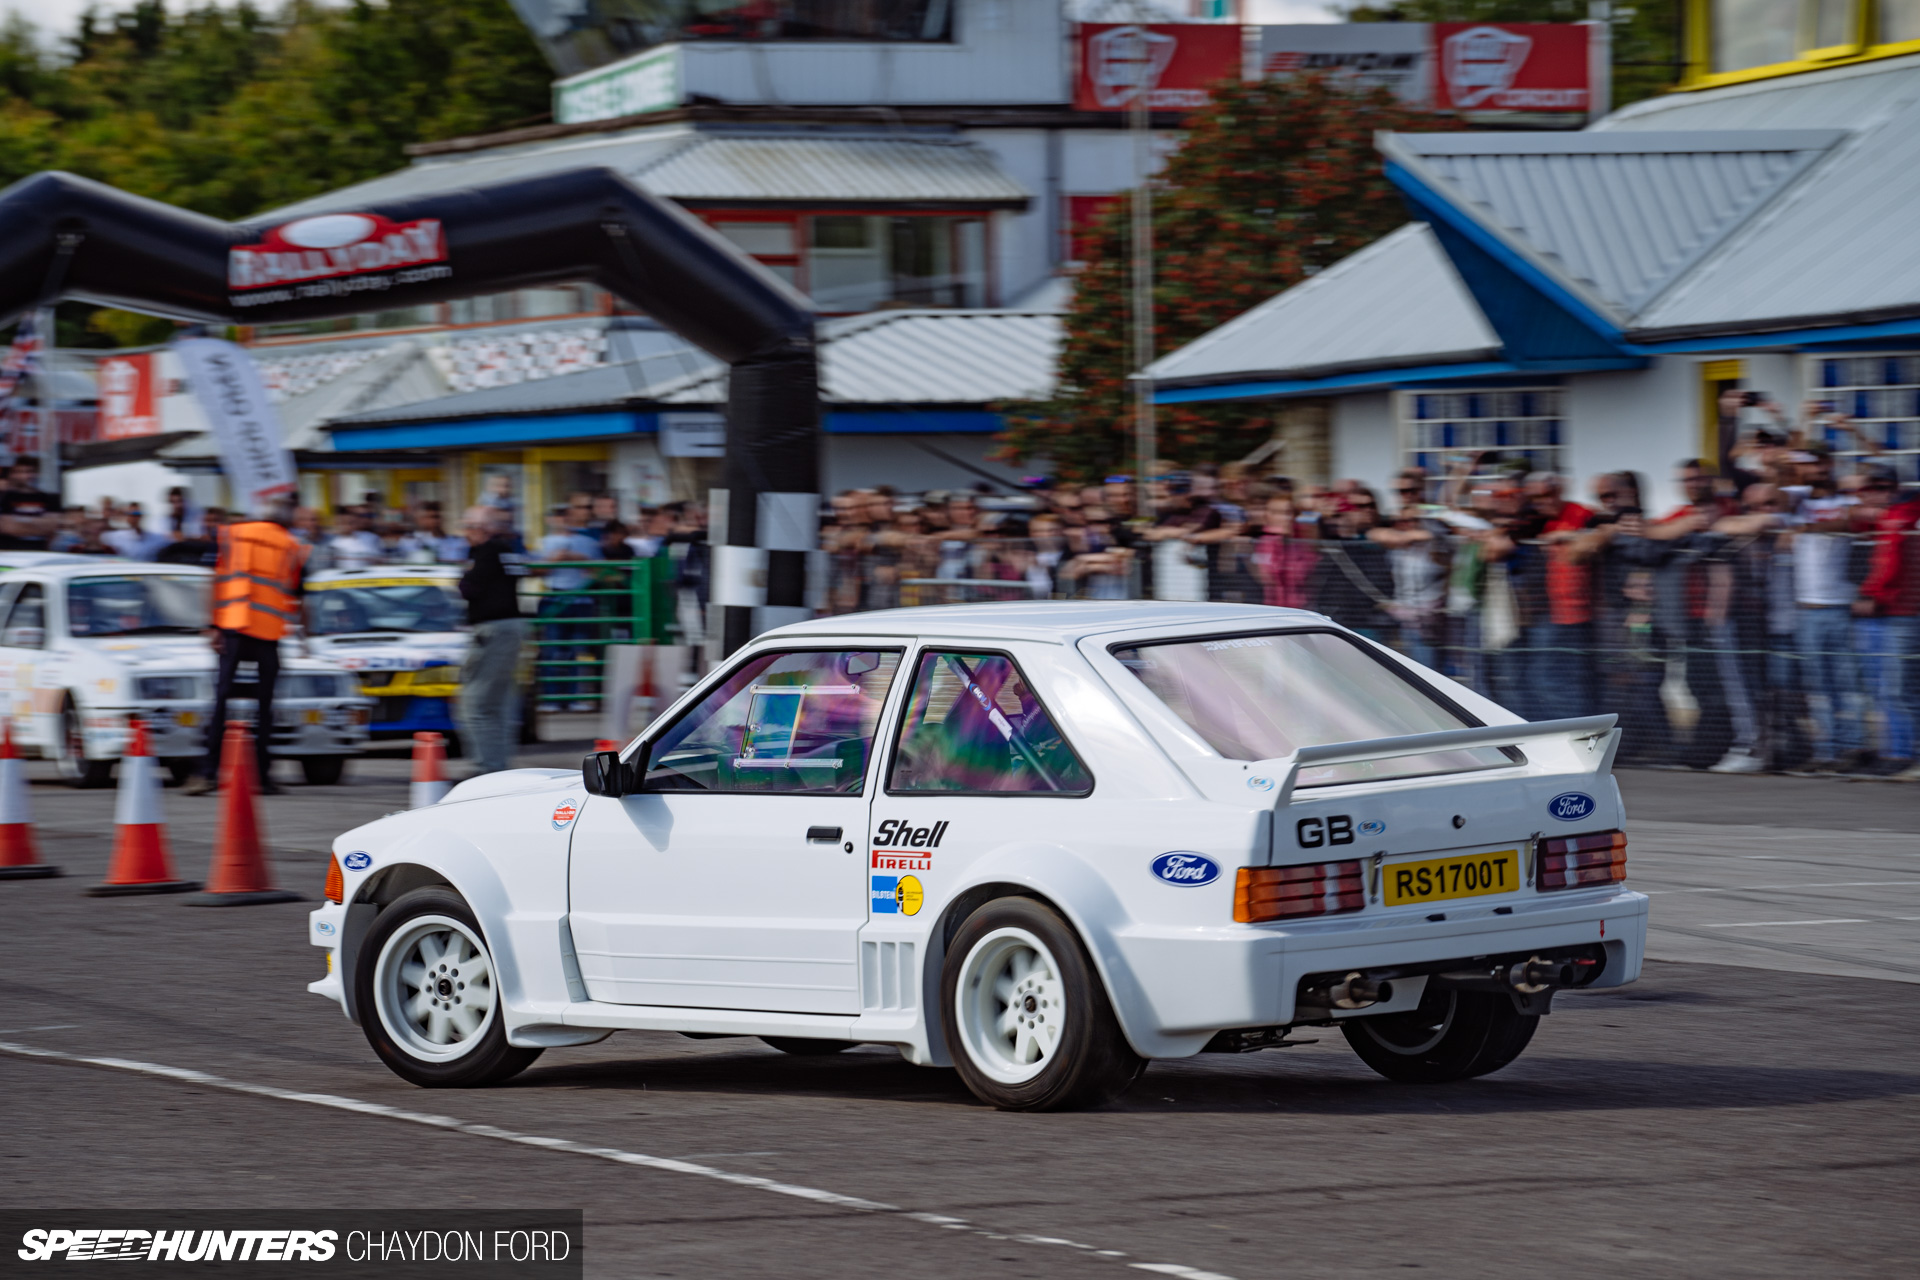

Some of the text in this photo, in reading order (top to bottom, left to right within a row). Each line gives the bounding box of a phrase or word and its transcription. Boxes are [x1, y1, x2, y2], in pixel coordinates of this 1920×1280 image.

[229, 219, 441, 286] RALLYDAY
[1557, 796, 1586, 816] Ford
[873, 820, 950, 848] Shell
[1298, 815, 1354, 849] GB
[347, 854, 368, 868] Ford
[871, 850, 932, 870] PIRELLI
[1163, 855, 1206, 881] Ford
[1396, 859, 1509, 899] RS1700T
[872, 890, 896, 900] BILSTEIN
